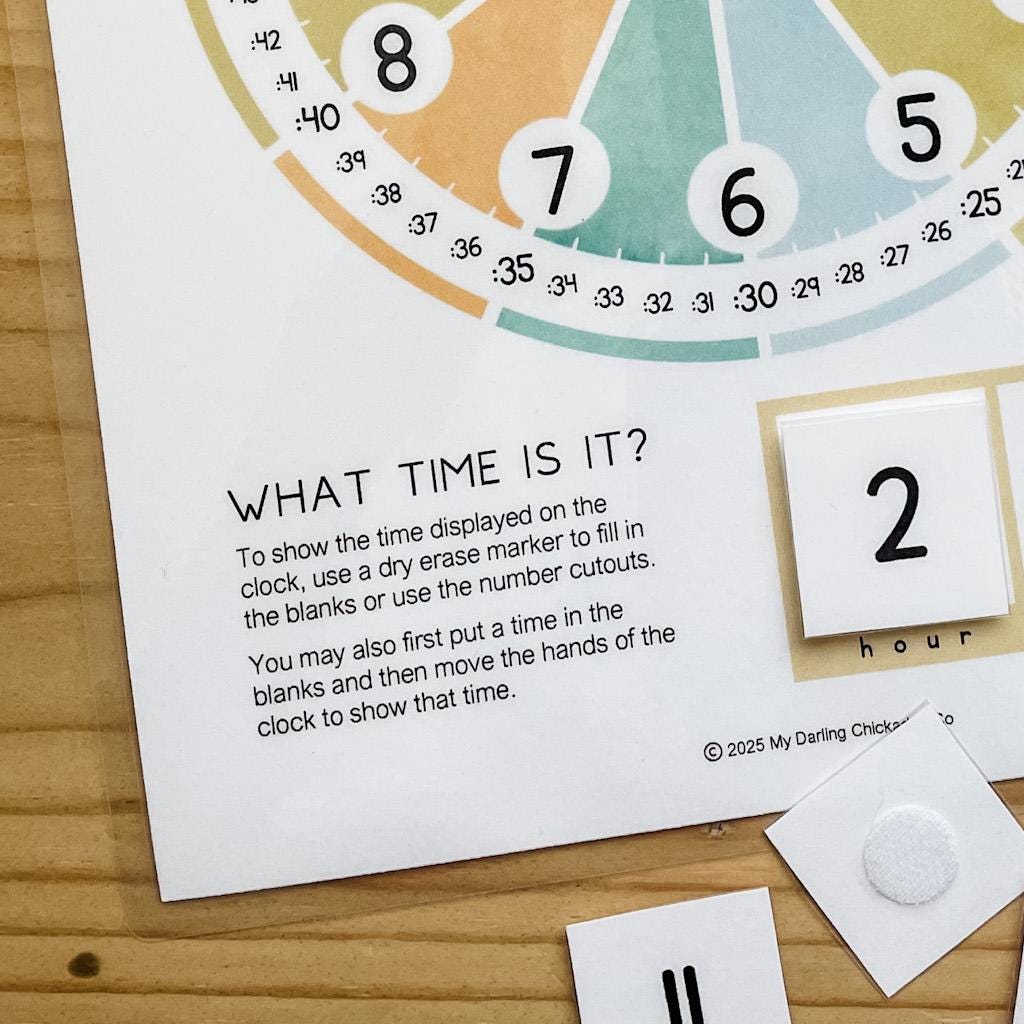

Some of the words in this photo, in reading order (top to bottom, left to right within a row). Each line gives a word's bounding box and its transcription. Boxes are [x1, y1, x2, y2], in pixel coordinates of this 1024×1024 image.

[250, 29, 282, 51] :42
[373, 23, 417, 93] 8
[276, 71, 299, 92] :41
[295, 102, 341, 133] :40
[896, 91, 942, 163] 5
[335, 149, 367, 174] :39
[370, 182, 402, 206] :38
[530, 144, 574, 216] 7
[721, 166, 765, 238] 6
[960, 186, 1002, 219] :25
[408, 211, 438, 236] :37
[921, 219, 952, 243] :26
[450, 235, 483, 260] :36
[879, 243, 910, 268] :27
[492, 252, 535, 286] :35
[547, 272, 578, 297] :34
[834, 261, 865, 285] :28
[593, 285, 625, 309] :33
[643, 291, 674, 315] :32
[691, 291, 715, 314] :31
[733, 280, 778, 313] :30
[790, 276, 821, 299] :29
[226, 468, 371, 523] WHAT
[397, 449, 501, 497] TIME
[523, 441, 562, 479] IS
[584, 427, 647, 470] IT?
[866, 466, 929, 564] 2
[235, 546, 266, 569] To
[271, 540, 329, 564] show
[334, 532, 370, 554] the
[376, 525, 424, 548] time
[430, 503, 533, 540] displayed
[539, 503, 567, 522] on
[572, 495, 607, 517] the
[240, 571, 306, 599] clock,
[312, 567, 352, 588] use
[358, 564, 372, 582] a
[378, 555, 413, 581] dry
[419, 547, 481, 572] erase
[486, 533, 564, 561] marker
[569, 528, 591, 548] to
[596, 521, 619, 544] fill
[624, 519, 644, 540] in
[243, 608, 280, 630] the
[284, 595, 357, 624] blanks
[363, 592, 387, 612] or
[392, 586, 432, 607] use
[436, 578, 472, 600] the
[479, 565, 563, 594] number
[569, 550, 656, 580] cutouts.
[247, 653, 293, 675] You
[299, 646, 346, 669] may
[352, 637, 397, 661] also
[401, 627, 444, 653] first
[449, 621, 486, 650] put
[491, 622, 505, 639] a
[510, 613, 558, 635] time
[563, 606, 583, 627] in
[588, 601, 624, 623] the
[859, 629, 973, 659] hour
[253, 678, 326, 707] blanks
[331, 668, 373, 695] and
[378, 665, 428, 688] then
[434, 654, 495, 679] move
[499, 647, 535, 668] the
[541, 633, 609, 662] hands
[615, 626, 636, 651] of
[640, 624, 676, 646] the
[257, 710, 317, 738] clock
[321, 708, 344, 728] to
[349, 699, 408, 724] show
[413, 688, 458, 713] that
[462, 683, 516, 705] time.
[727, 737, 766, 758] 2025
[769, 735, 792, 750] My
[796, 726, 847, 746] Darling
